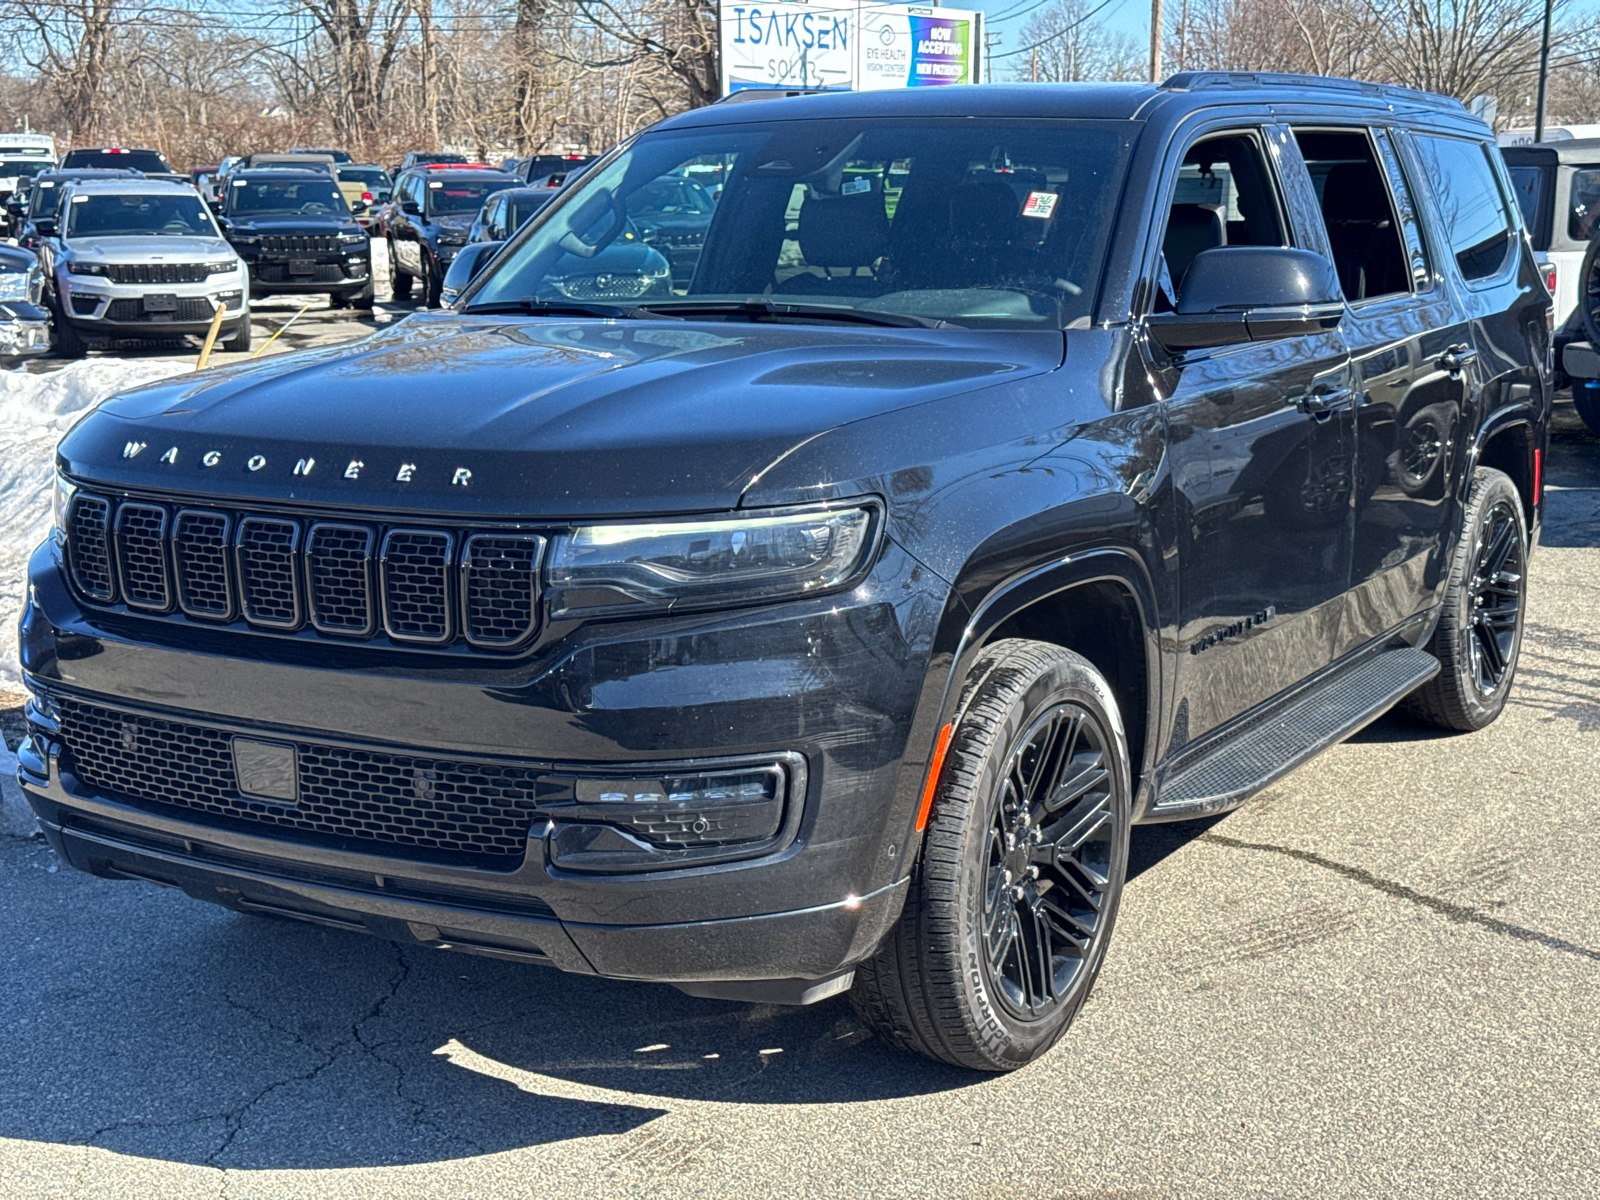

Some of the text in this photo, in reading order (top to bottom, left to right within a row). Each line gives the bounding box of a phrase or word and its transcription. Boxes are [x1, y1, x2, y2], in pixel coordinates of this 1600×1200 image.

[733, 7, 848, 51] ISAKSEN
[930, 27, 952, 41] NOW
[866, 47, 906, 60] EYE HEALTH
[917, 40, 963, 56] ACCEPTING
[768, 58, 817, 80] SOLAR
[866, 62, 906, 73] VISION CENTERS
[916, 63, 932, 75] NEW
[122, 440, 473, 487] WAGONEER
[968, 952, 1012, 1047] SCORPION
